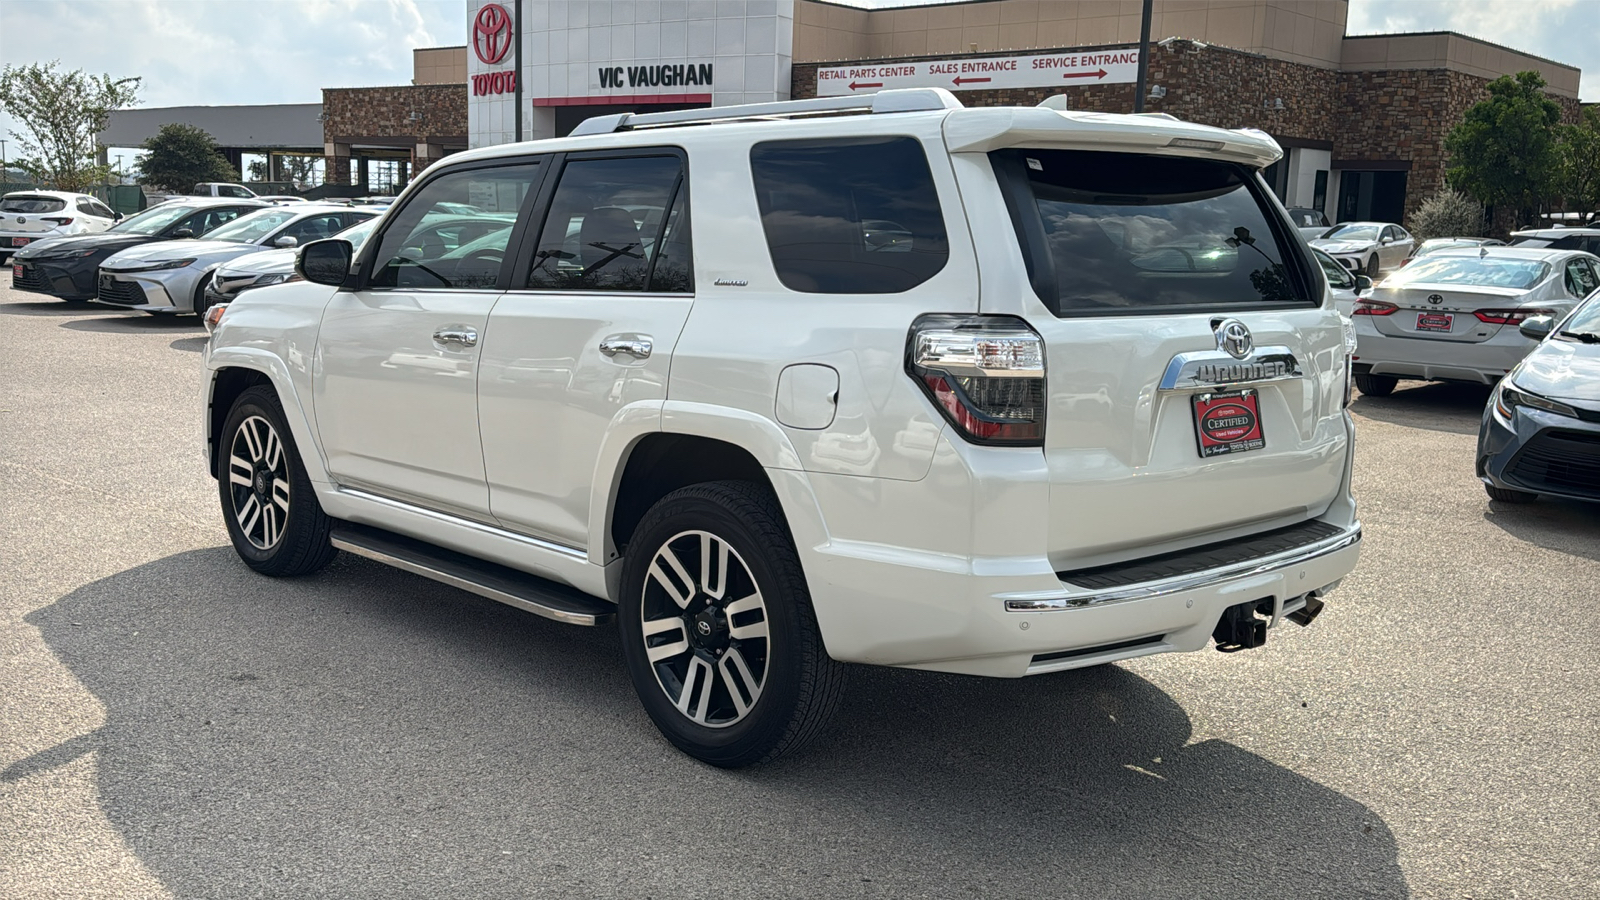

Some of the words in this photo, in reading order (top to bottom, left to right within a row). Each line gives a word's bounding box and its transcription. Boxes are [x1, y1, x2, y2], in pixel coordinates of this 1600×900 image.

[929, 63, 959, 75] SALES
[961, 60, 1017, 73] ENTRANCE
[1032, 57, 1078, 69] SERVICE
[1081, 52, 1140, 67] ENTRANC
[598, 66, 624, 88] VIC
[627, 63, 713, 88] VAUGHAN
[819, 70, 847, 80] RETAIL
[849, 68, 877, 79] PARTS
[878, 66, 915, 77] CENTER
